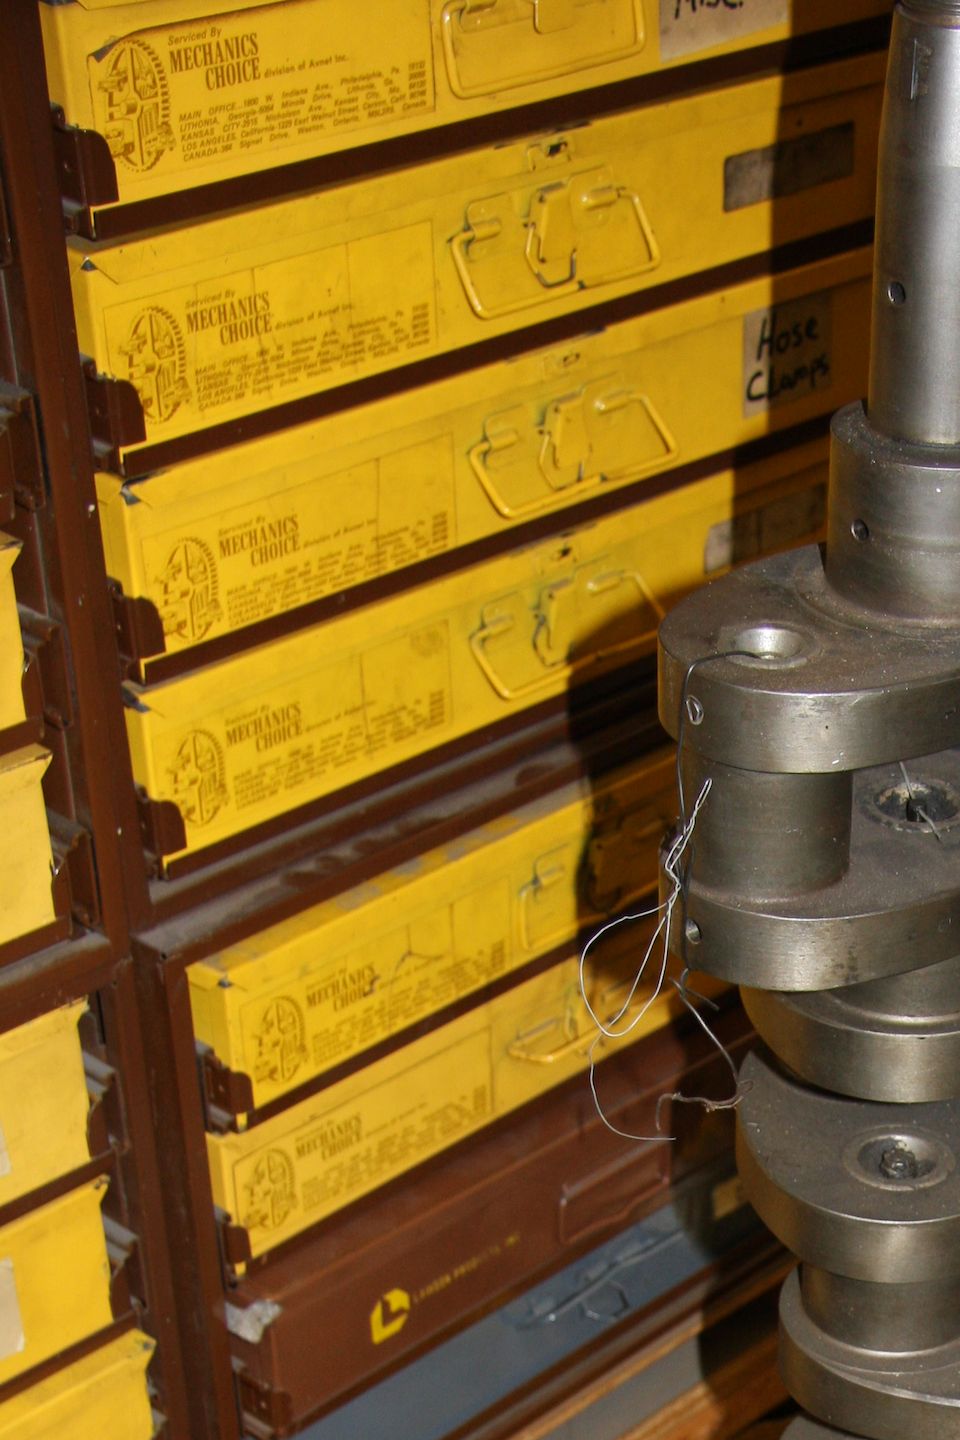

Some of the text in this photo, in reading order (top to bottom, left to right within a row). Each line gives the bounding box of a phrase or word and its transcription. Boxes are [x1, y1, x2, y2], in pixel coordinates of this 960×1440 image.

[167, 26, 223, 46] Serviced By
[168, 33, 259, 74] MECHANICS
[205, 57, 261, 92] CHOICE
[186, 291, 270, 334] MECHANICS
[220, 312, 272, 346] CHOICE
[756, 316, 819, 361] Hose
[746, 351, 831, 402] Clamps
[219, 514, 299, 559] MECHANICS
[250, 534, 301, 567] CHOICE
[225, 702, 302, 748] MECHANICS
[255, 720, 303, 753] CHOICE
[306, 961, 377, 1008] MECHANICS
[295, 1112, 362, 1160] MECHANICS
